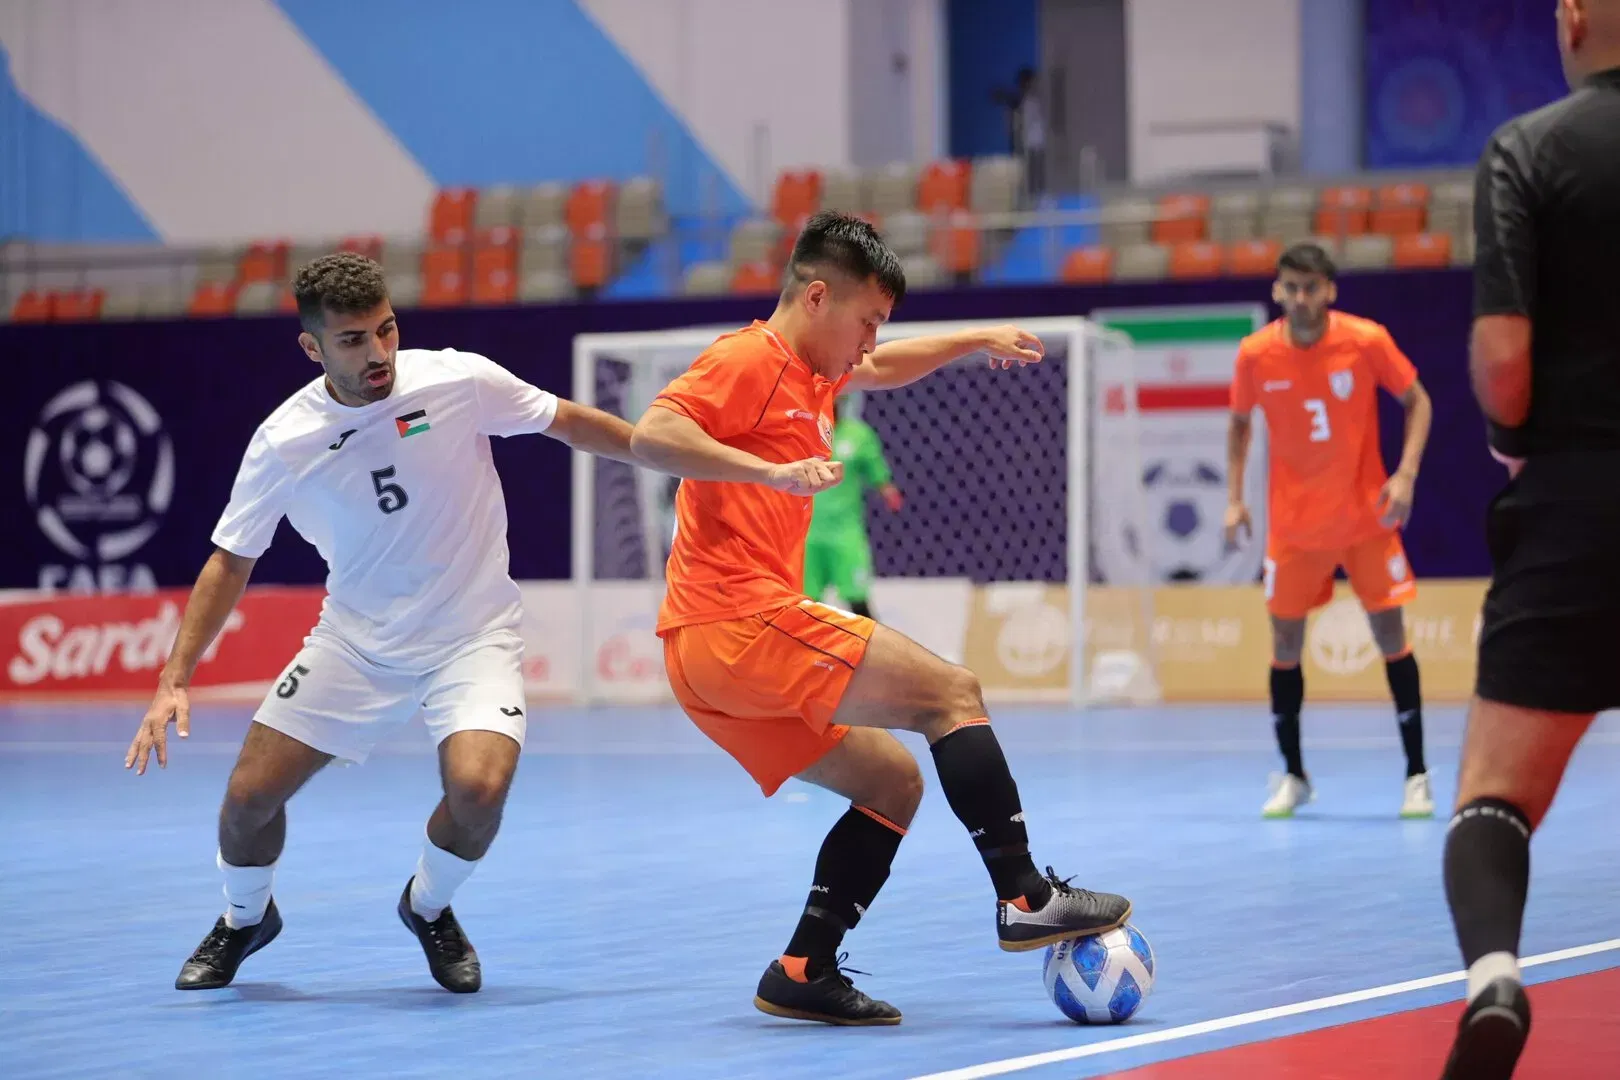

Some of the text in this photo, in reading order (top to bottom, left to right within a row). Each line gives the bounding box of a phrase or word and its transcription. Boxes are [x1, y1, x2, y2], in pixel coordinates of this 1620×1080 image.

[1303, 399, 1331, 441] 3
[370, 464, 409, 514] 5
[8, 600, 245, 685] Sardr
[276, 664, 310, 699] 5
